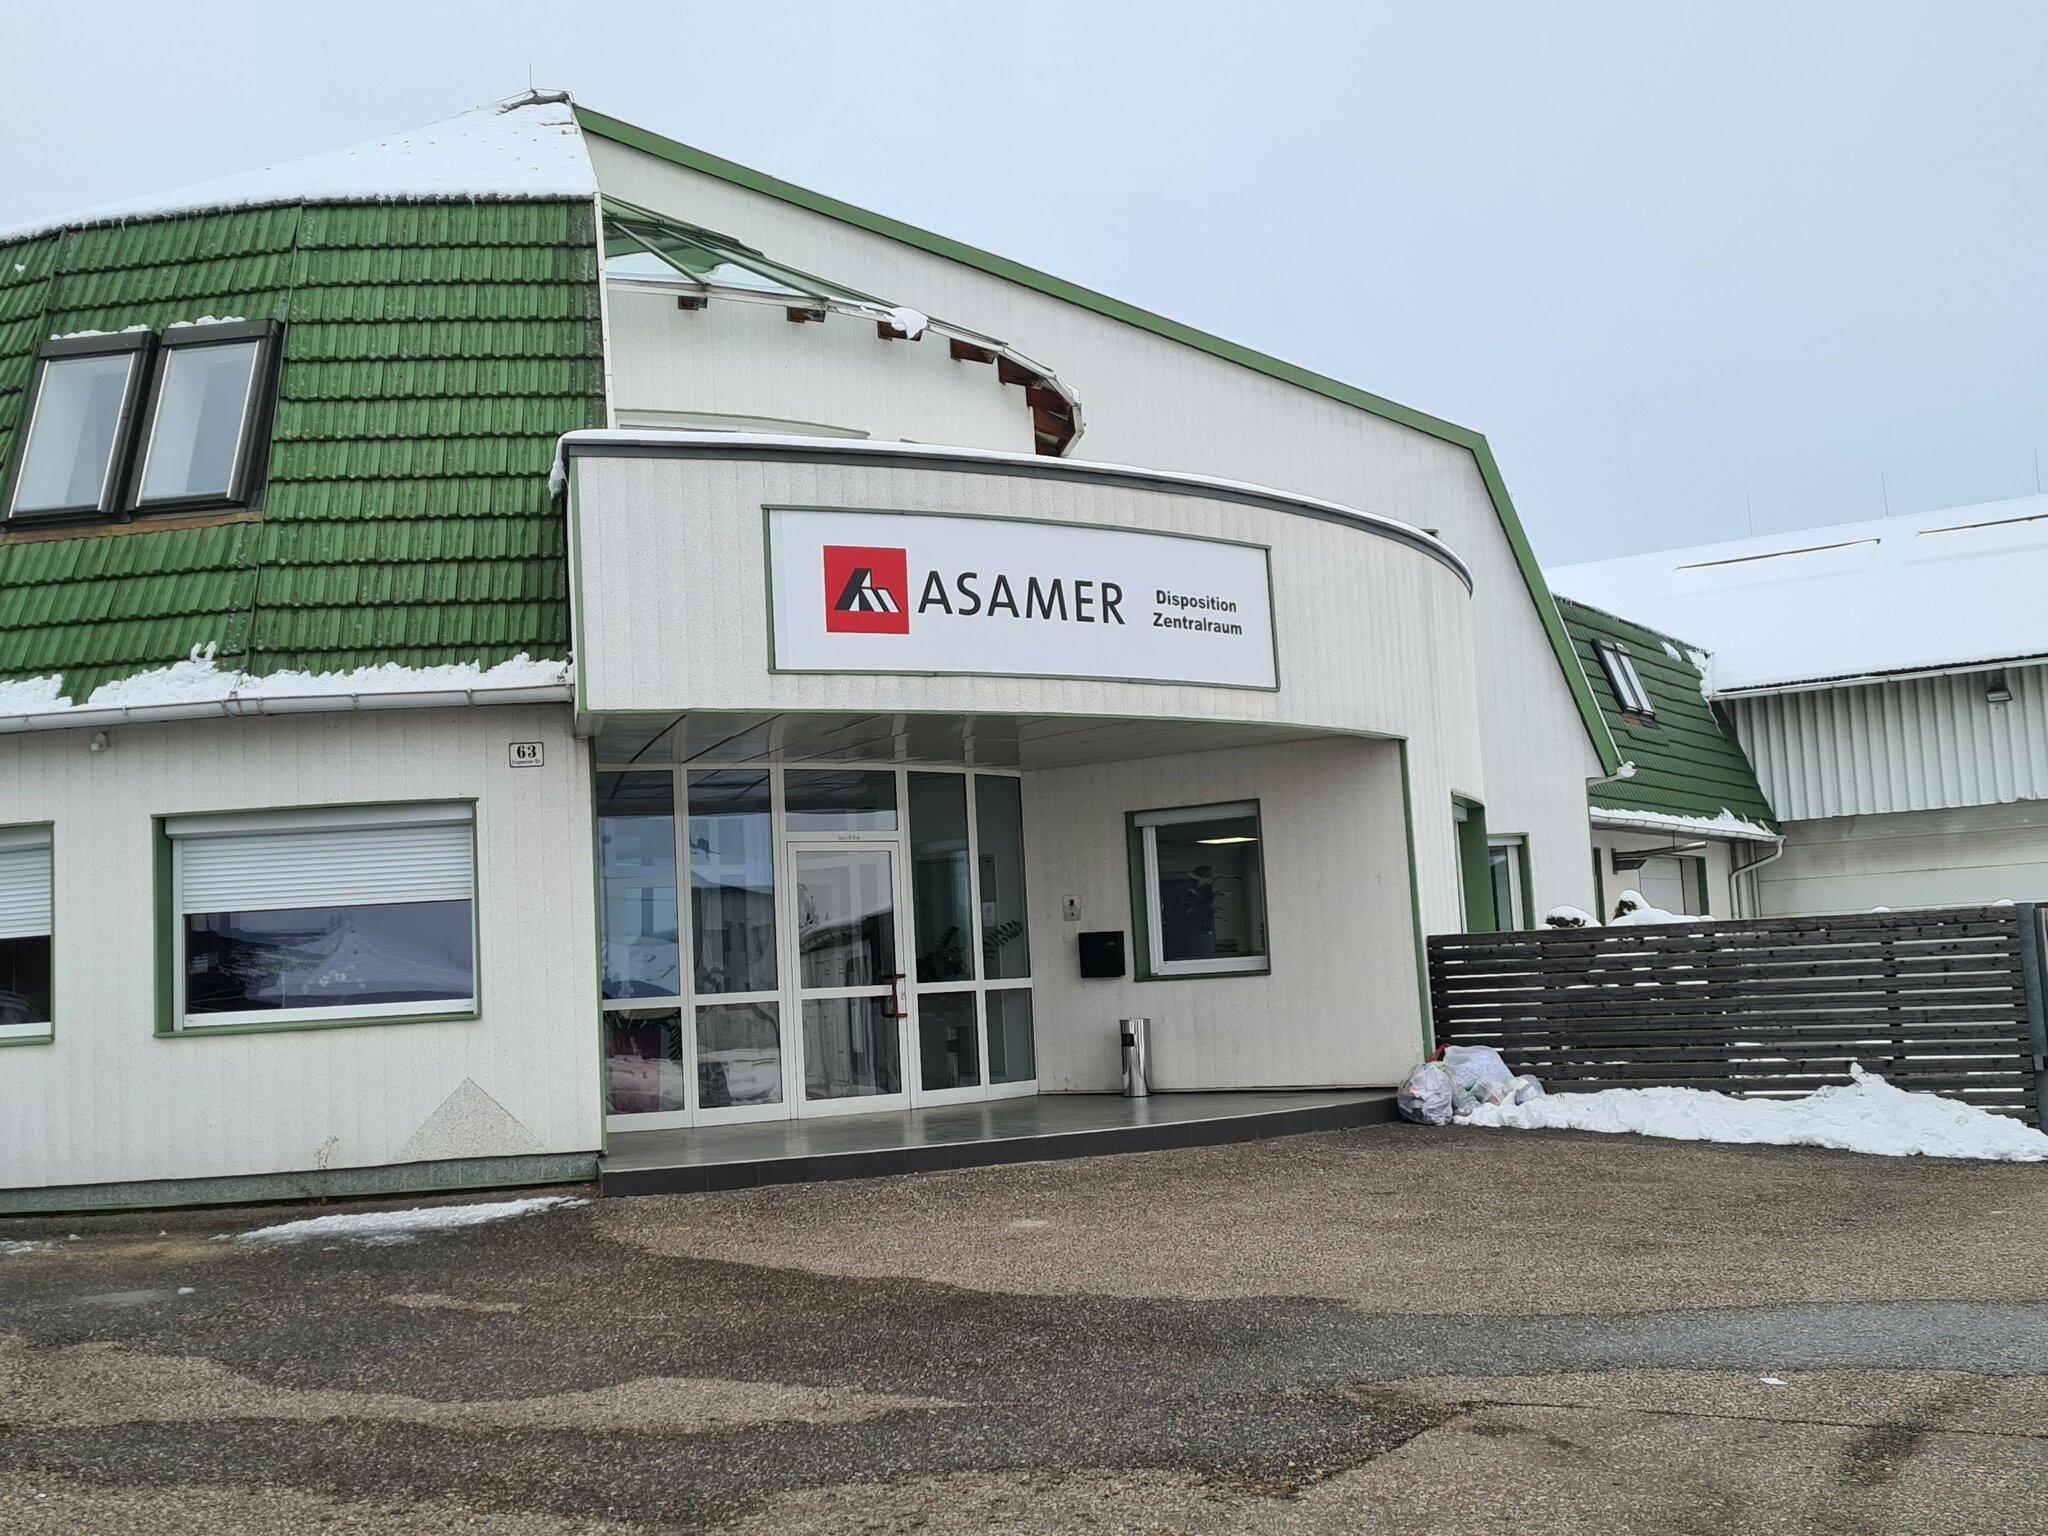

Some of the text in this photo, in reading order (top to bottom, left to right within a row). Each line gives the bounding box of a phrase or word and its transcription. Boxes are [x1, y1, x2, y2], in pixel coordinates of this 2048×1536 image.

[918, 570, 1126, 625] ASAMER
[1156, 589, 1237, 613] Disposition
[1152, 612, 1242, 635] Zentralraum
[517, 745, 537, 758] 63
